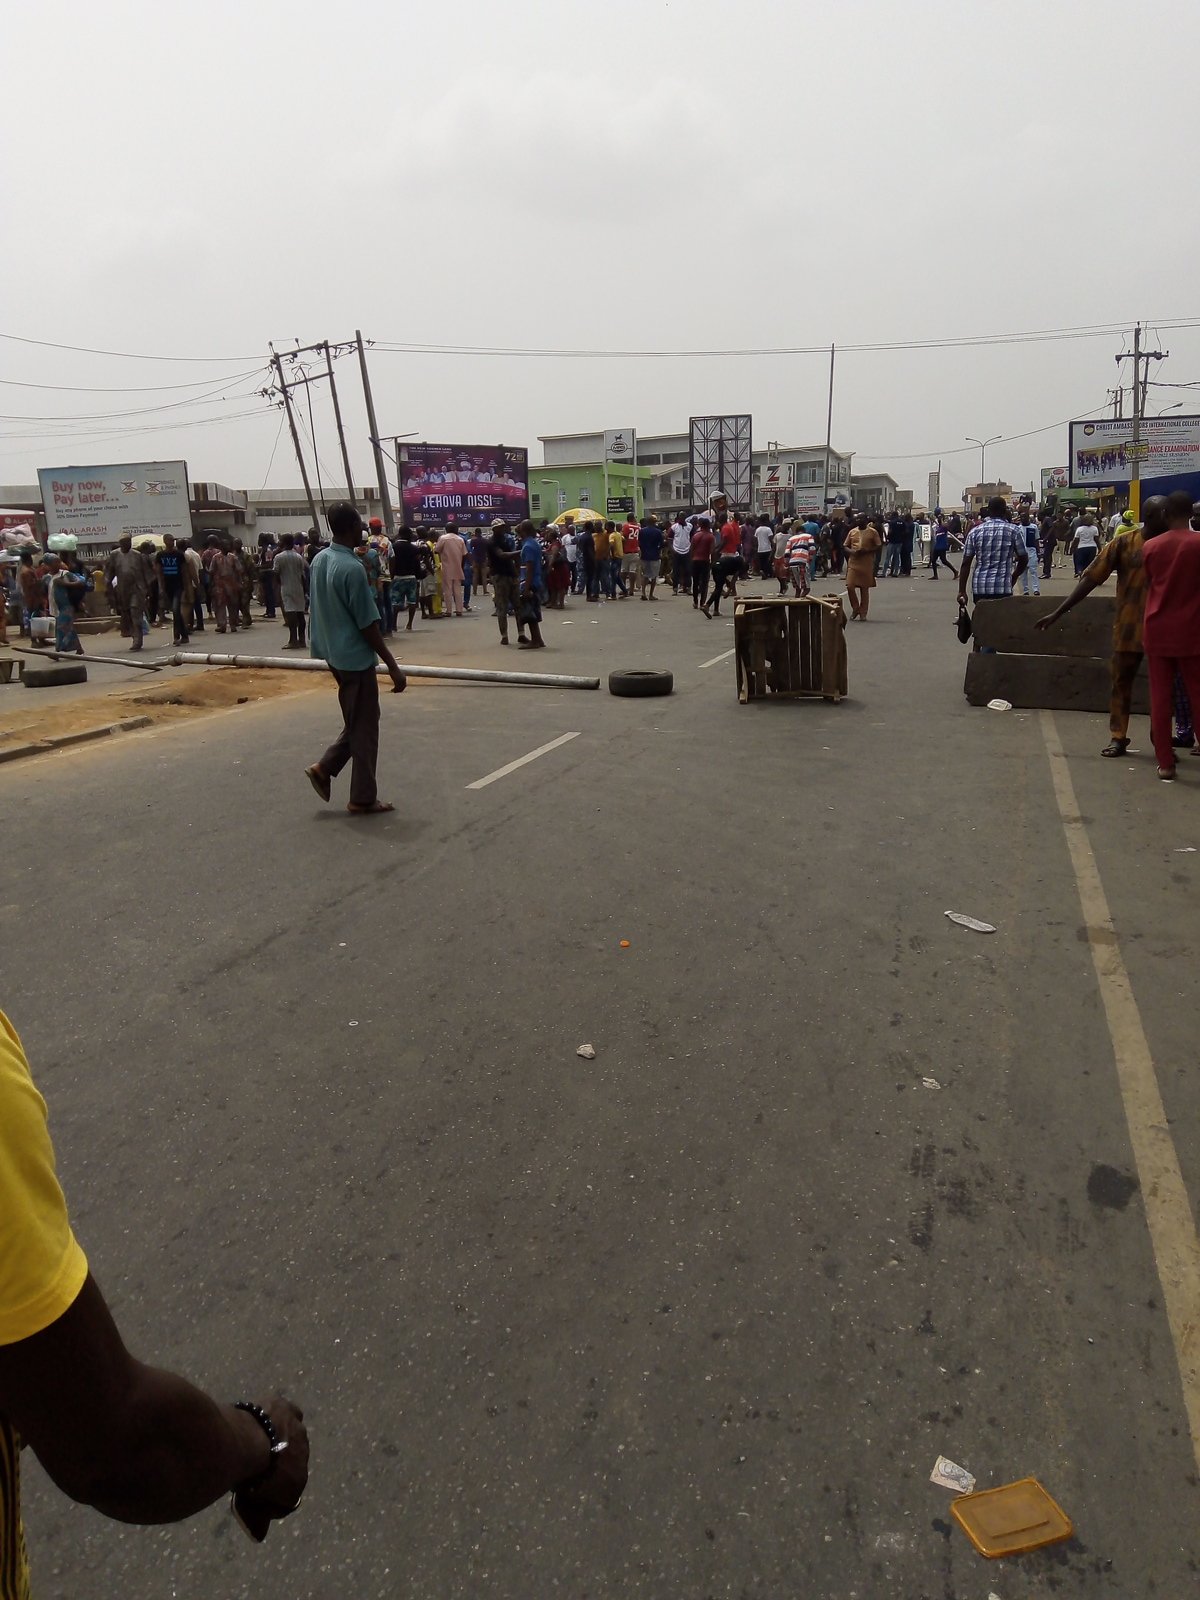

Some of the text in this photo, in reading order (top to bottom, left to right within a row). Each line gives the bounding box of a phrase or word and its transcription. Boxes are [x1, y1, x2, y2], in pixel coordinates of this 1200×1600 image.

[1113, 421, 1148, 429] AMBASSORS
[1164, 444, 1200, 452] EXAMINATION
[504, 452, 517, 461] 72
[767, 465, 780, 483] Z
[52, 481, 106, 494] Buy now,
[54, 492, 120, 507] Pay later...
[423, 495, 462, 508] JEHOVA
[467, 494, 492, 507] NISSI
[70, 525, 107, 534] AL-ARASH
[628, 527, 639, 540] 24
